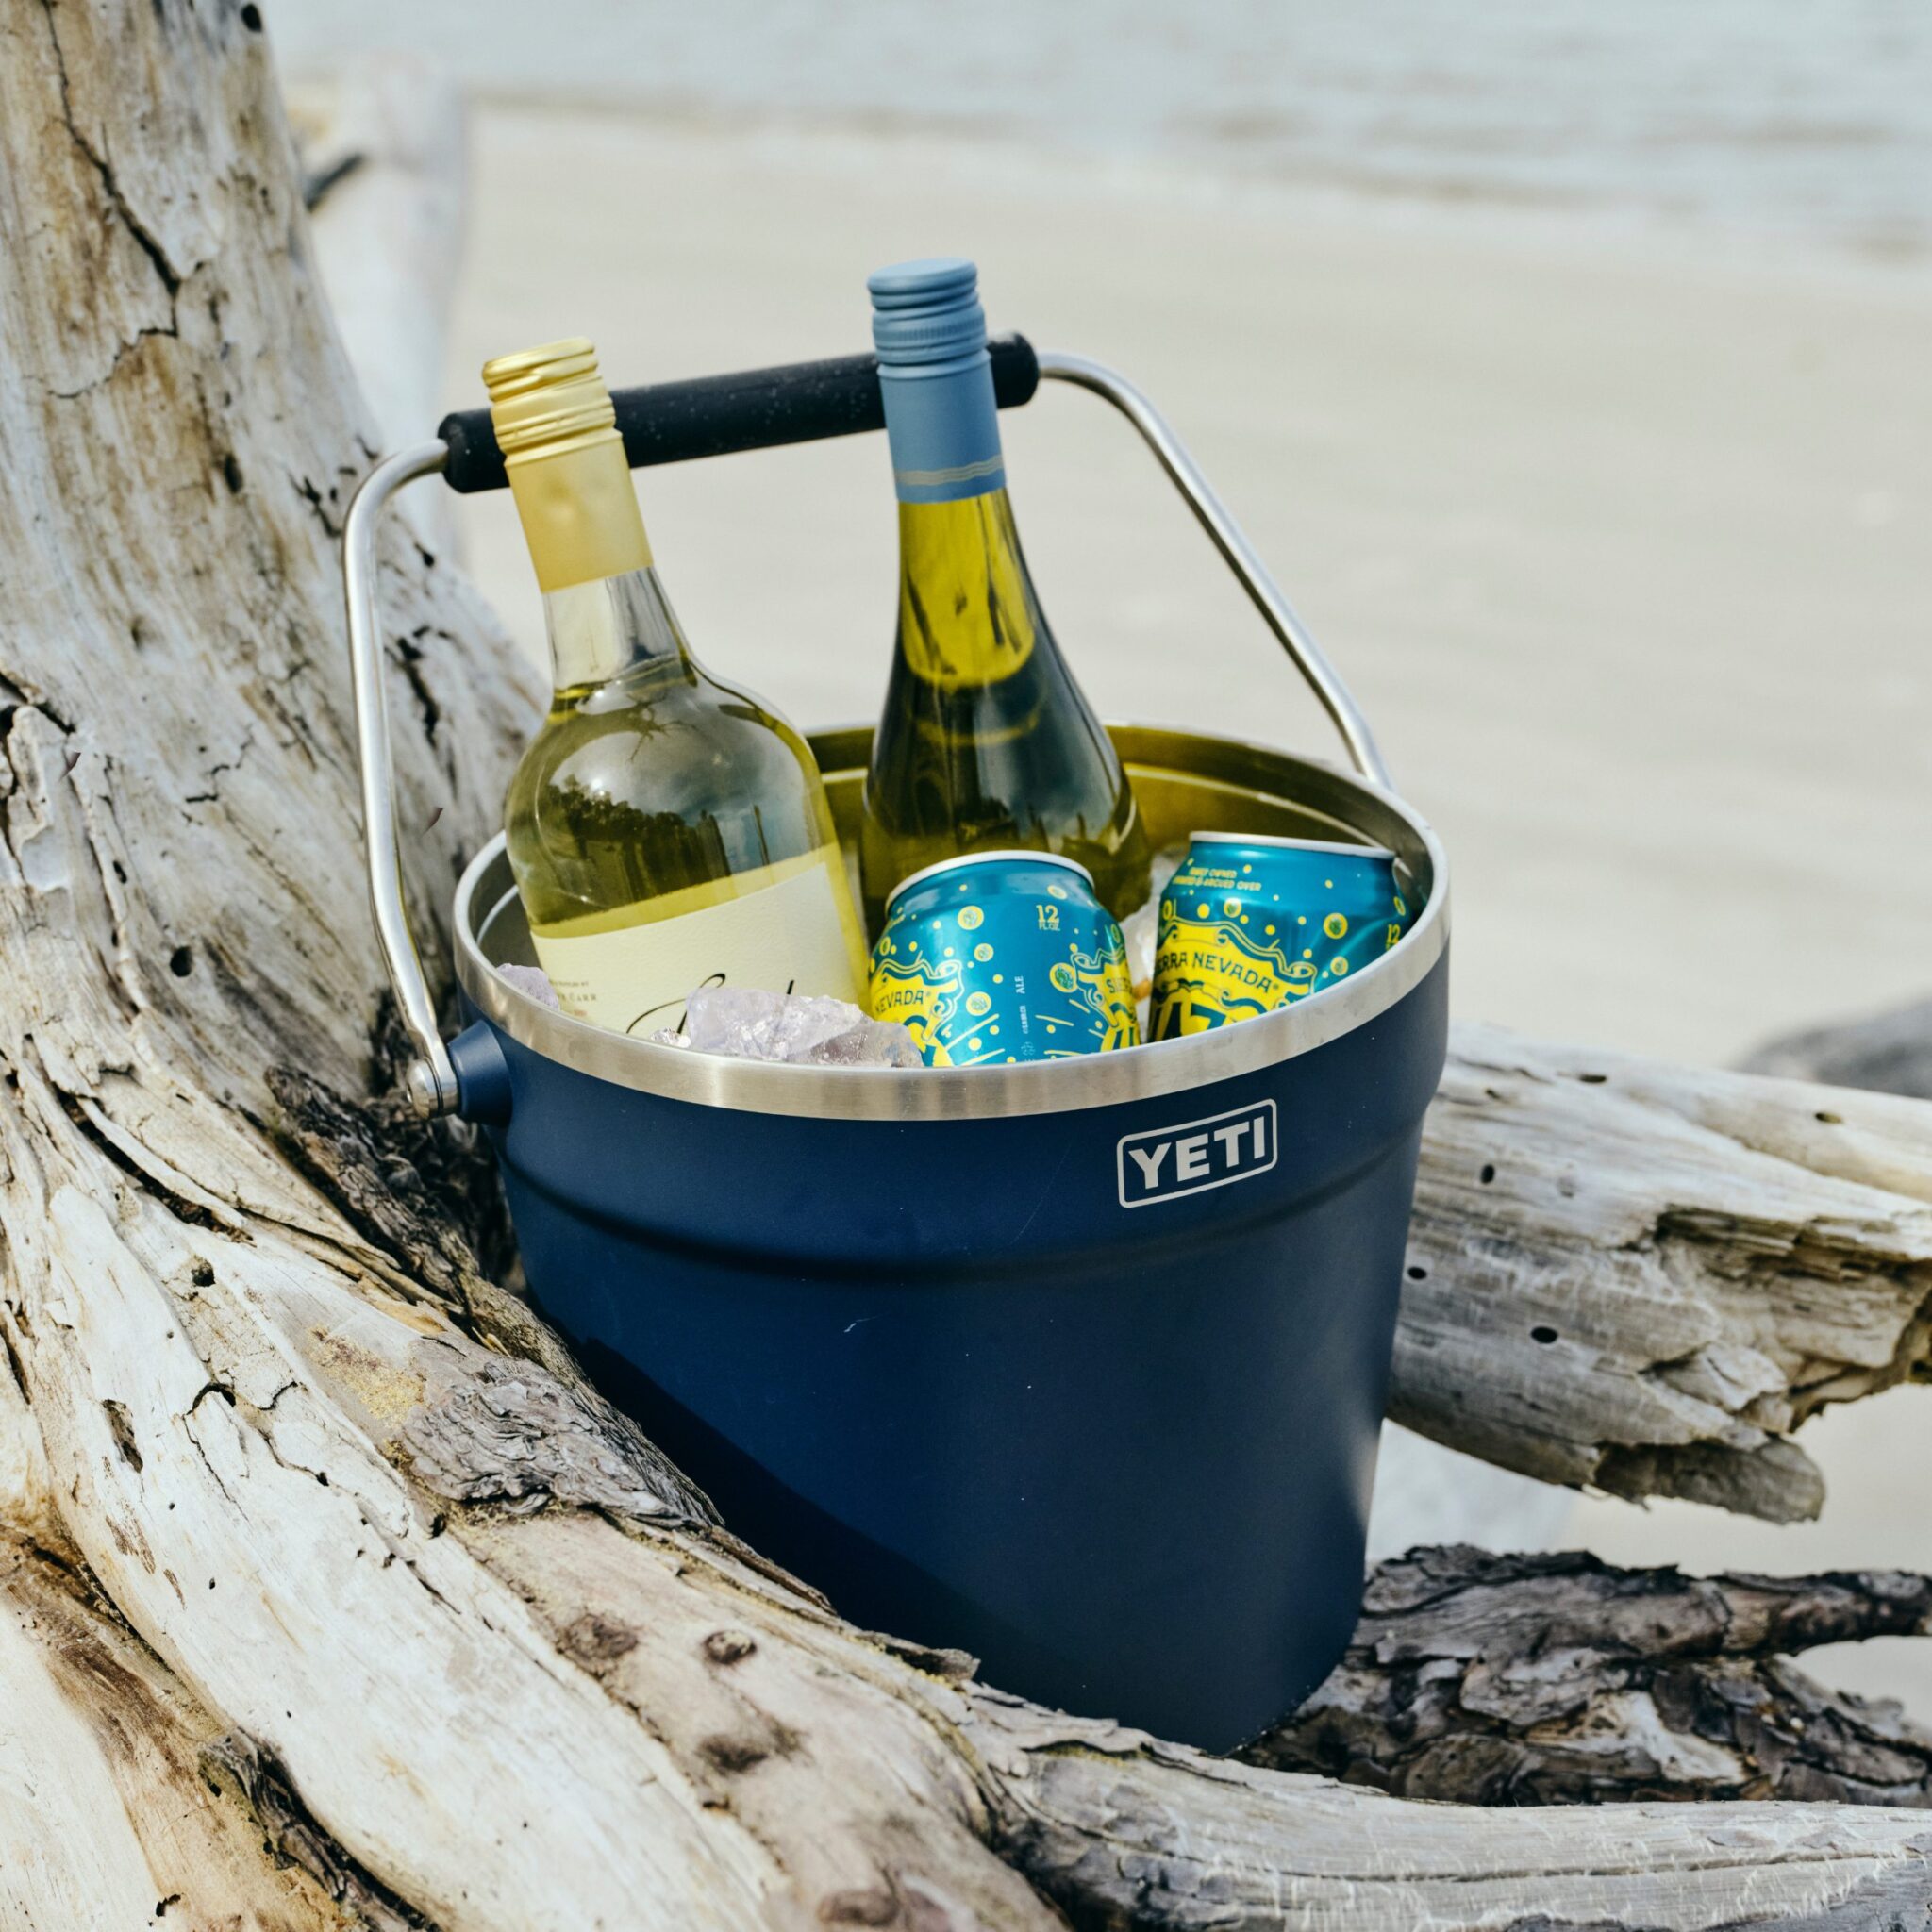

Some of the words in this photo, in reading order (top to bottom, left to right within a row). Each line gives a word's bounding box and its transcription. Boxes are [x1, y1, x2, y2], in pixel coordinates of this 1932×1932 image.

[1036, 905, 1059, 922] 12
[1387, 924, 1401, 944] 12
[1192, 951, 1272, 993] NEVADA
[1014, 975, 1025, 994] ALE
[1128, 1115, 1266, 1190] YETI
